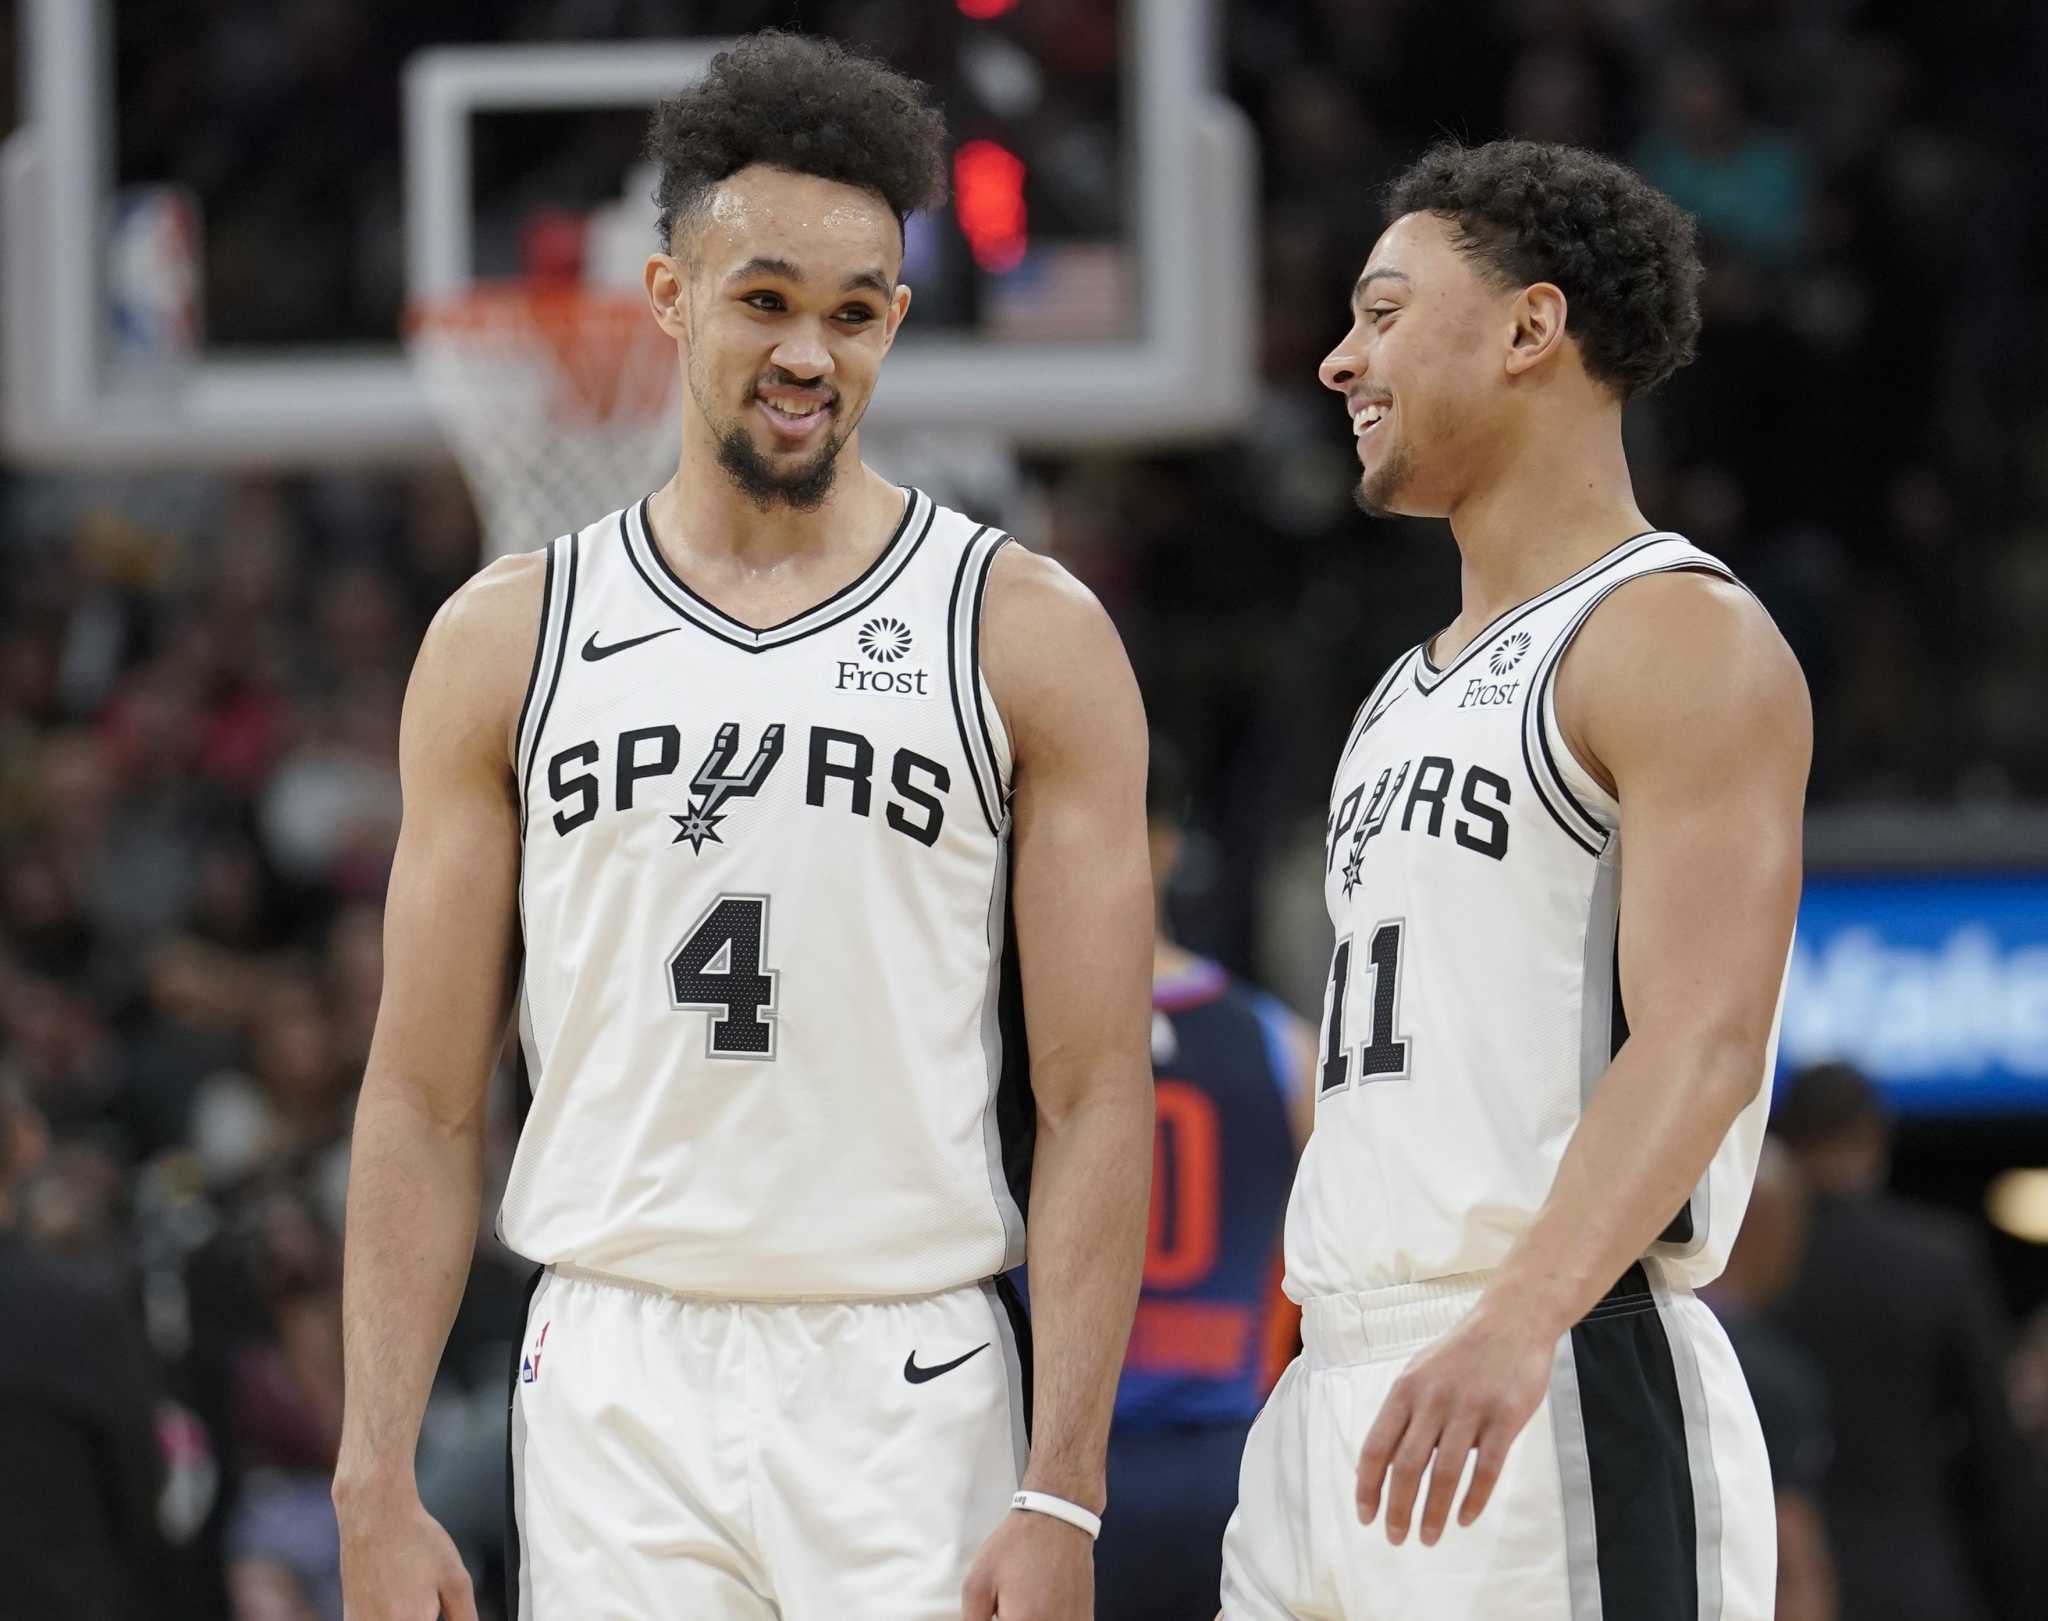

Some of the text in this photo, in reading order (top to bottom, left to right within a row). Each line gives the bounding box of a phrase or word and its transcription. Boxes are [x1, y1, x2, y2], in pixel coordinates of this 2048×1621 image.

[834, 661, 929, 695] Frost
[1457, 677, 1519, 708] Frost
[546, 723, 952, 857] SPURS
[1327, 756, 1512, 902] PURS
[664, 893, 780, 1061] 4
[1318, 917, 1413, 1100] 11
